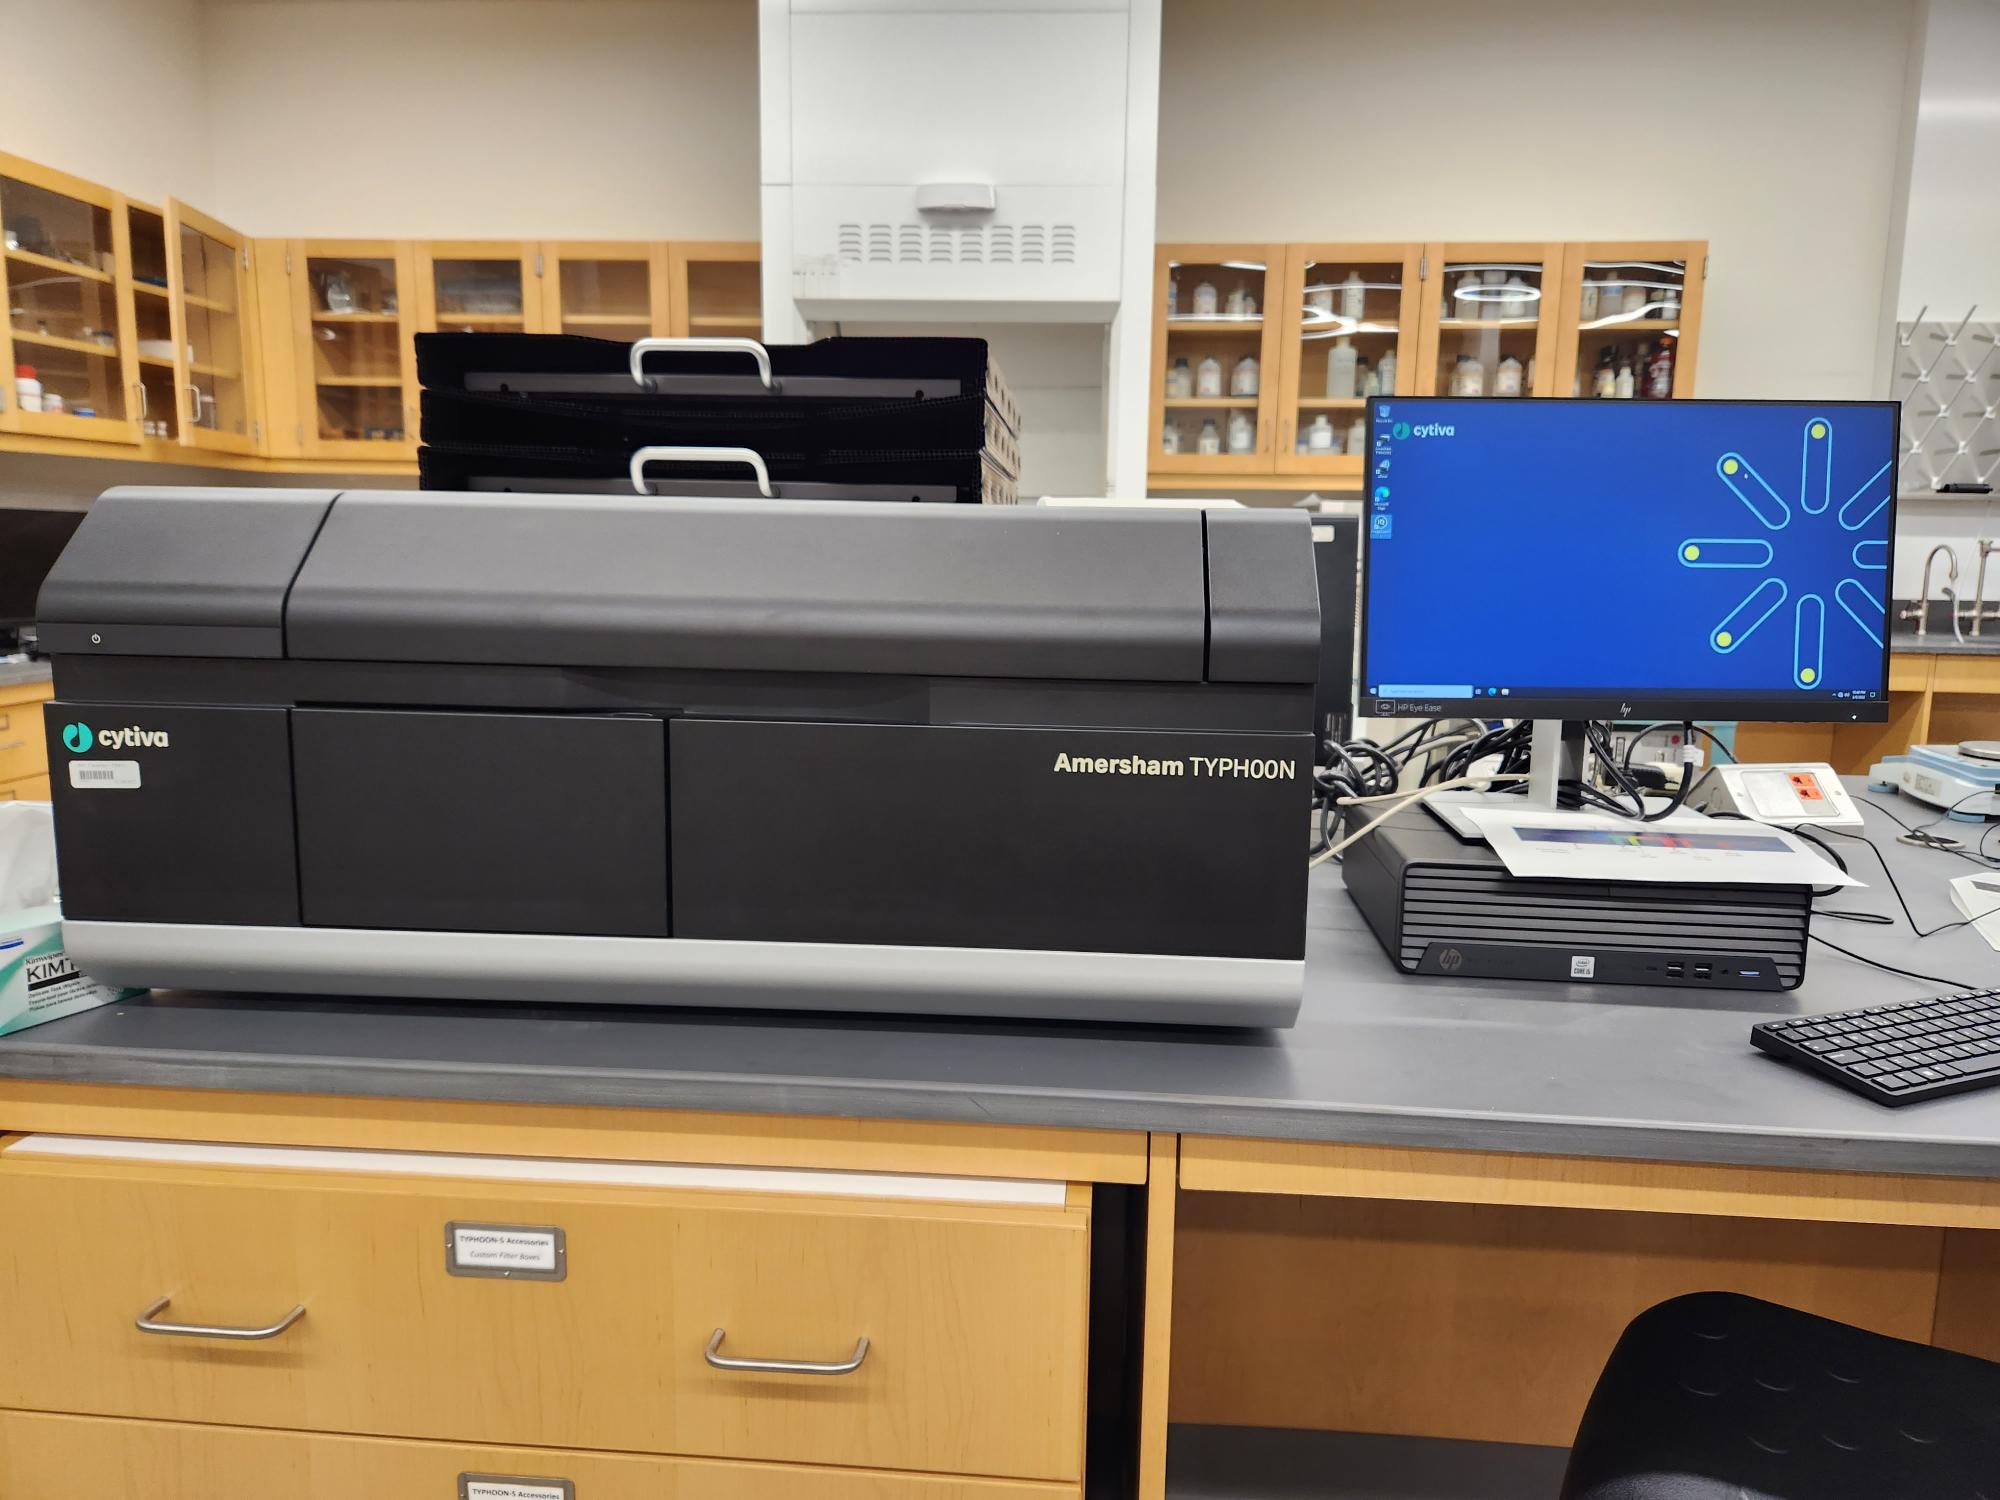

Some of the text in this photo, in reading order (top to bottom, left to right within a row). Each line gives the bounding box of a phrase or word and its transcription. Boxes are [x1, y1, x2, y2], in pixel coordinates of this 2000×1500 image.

[1413, 422, 1455, 438] cytiva
[1397, 703, 1442, 713] HP Eye Ease
[98, 725, 169, 750] cytiva
[1053, 752, 1296, 780] Amersham TYPHOON
[507, 1237, 549, 1246] Accessories
[518, 1491, 560, 1500] Accessories
